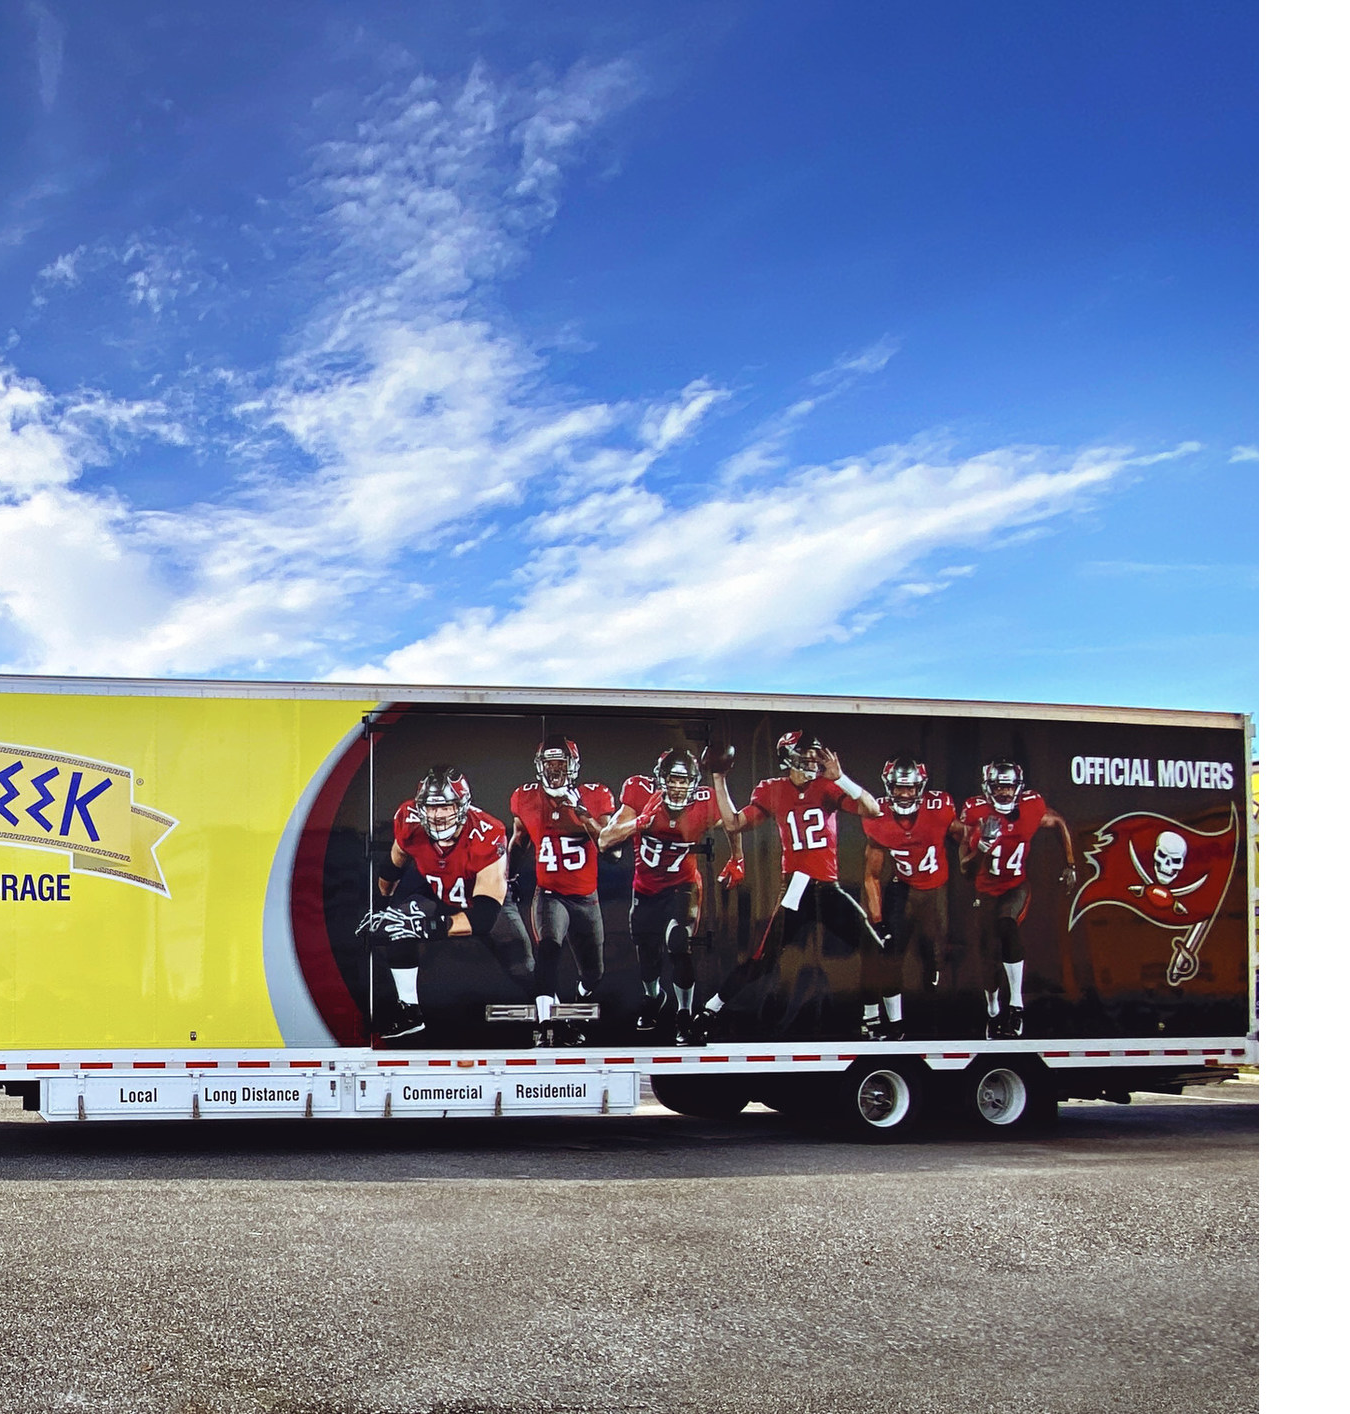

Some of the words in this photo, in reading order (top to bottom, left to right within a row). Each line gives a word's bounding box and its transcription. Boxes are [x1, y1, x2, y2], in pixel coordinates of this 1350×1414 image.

[1071, 756, 1154, 787] OFFICIAL
[1157, 759, 1234, 790] MOVERS
[469, 819, 493, 842] 74
[786, 808, 827, 851] 12
[538, 836, 586, 872] 45
[639, 835, 696, 872] 87
[890, 845, 939, 877] 54
[989, 842, 1025, 876] 14
[425, 874, 468, 909] 74
[119, 1087, 158, 1103] Local
[204, 1086, 237, 1104] Long
[242, 1086, 300, 1102] Distance
[402, 1085, 483, 1102] Commercial
[515, 1083, 587, 1099] Residential
